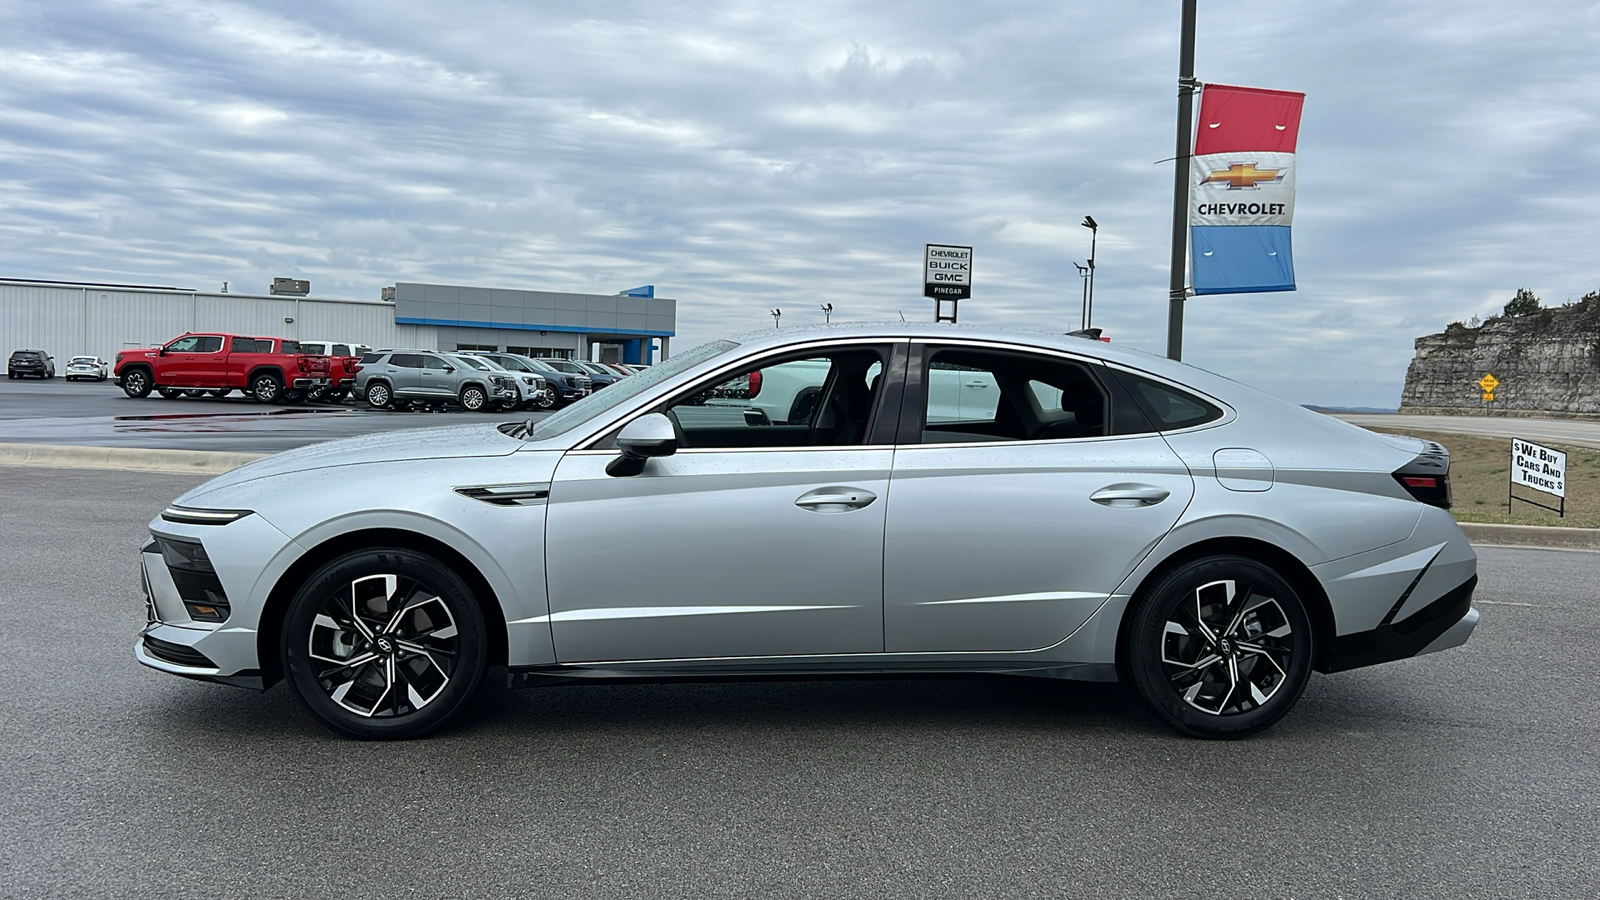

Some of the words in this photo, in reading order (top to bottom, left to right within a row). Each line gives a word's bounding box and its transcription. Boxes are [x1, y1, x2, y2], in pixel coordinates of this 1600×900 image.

[930, 249, 969, 259] CHEVROLET
[929, 261, 968, 271] BUICK
[934, 273, 963, 282] GMC
[934, 287, 962, 295] PINEGAR
